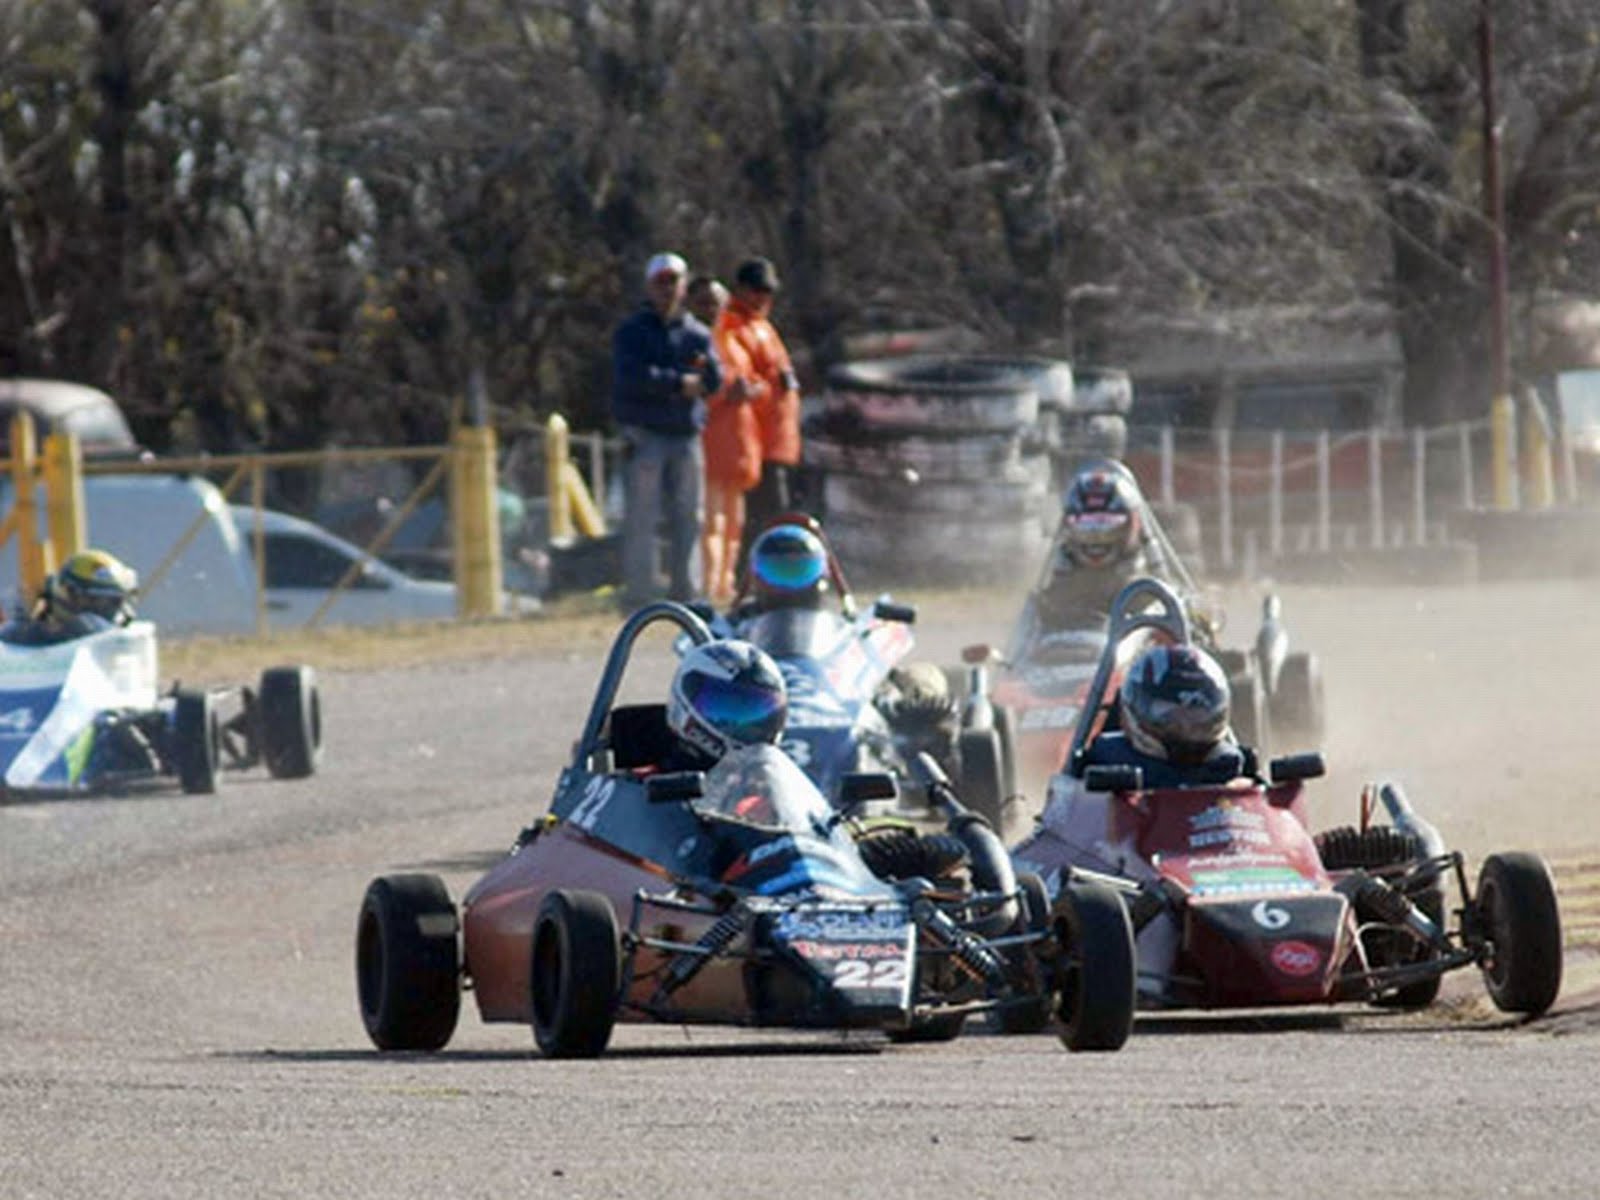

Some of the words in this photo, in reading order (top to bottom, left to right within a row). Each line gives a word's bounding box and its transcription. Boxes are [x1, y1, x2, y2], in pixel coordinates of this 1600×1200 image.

[569, 774, 616, 829] 22
[1252, 899, 1291, 930] 6
[832, 959, 906, 988] 22
